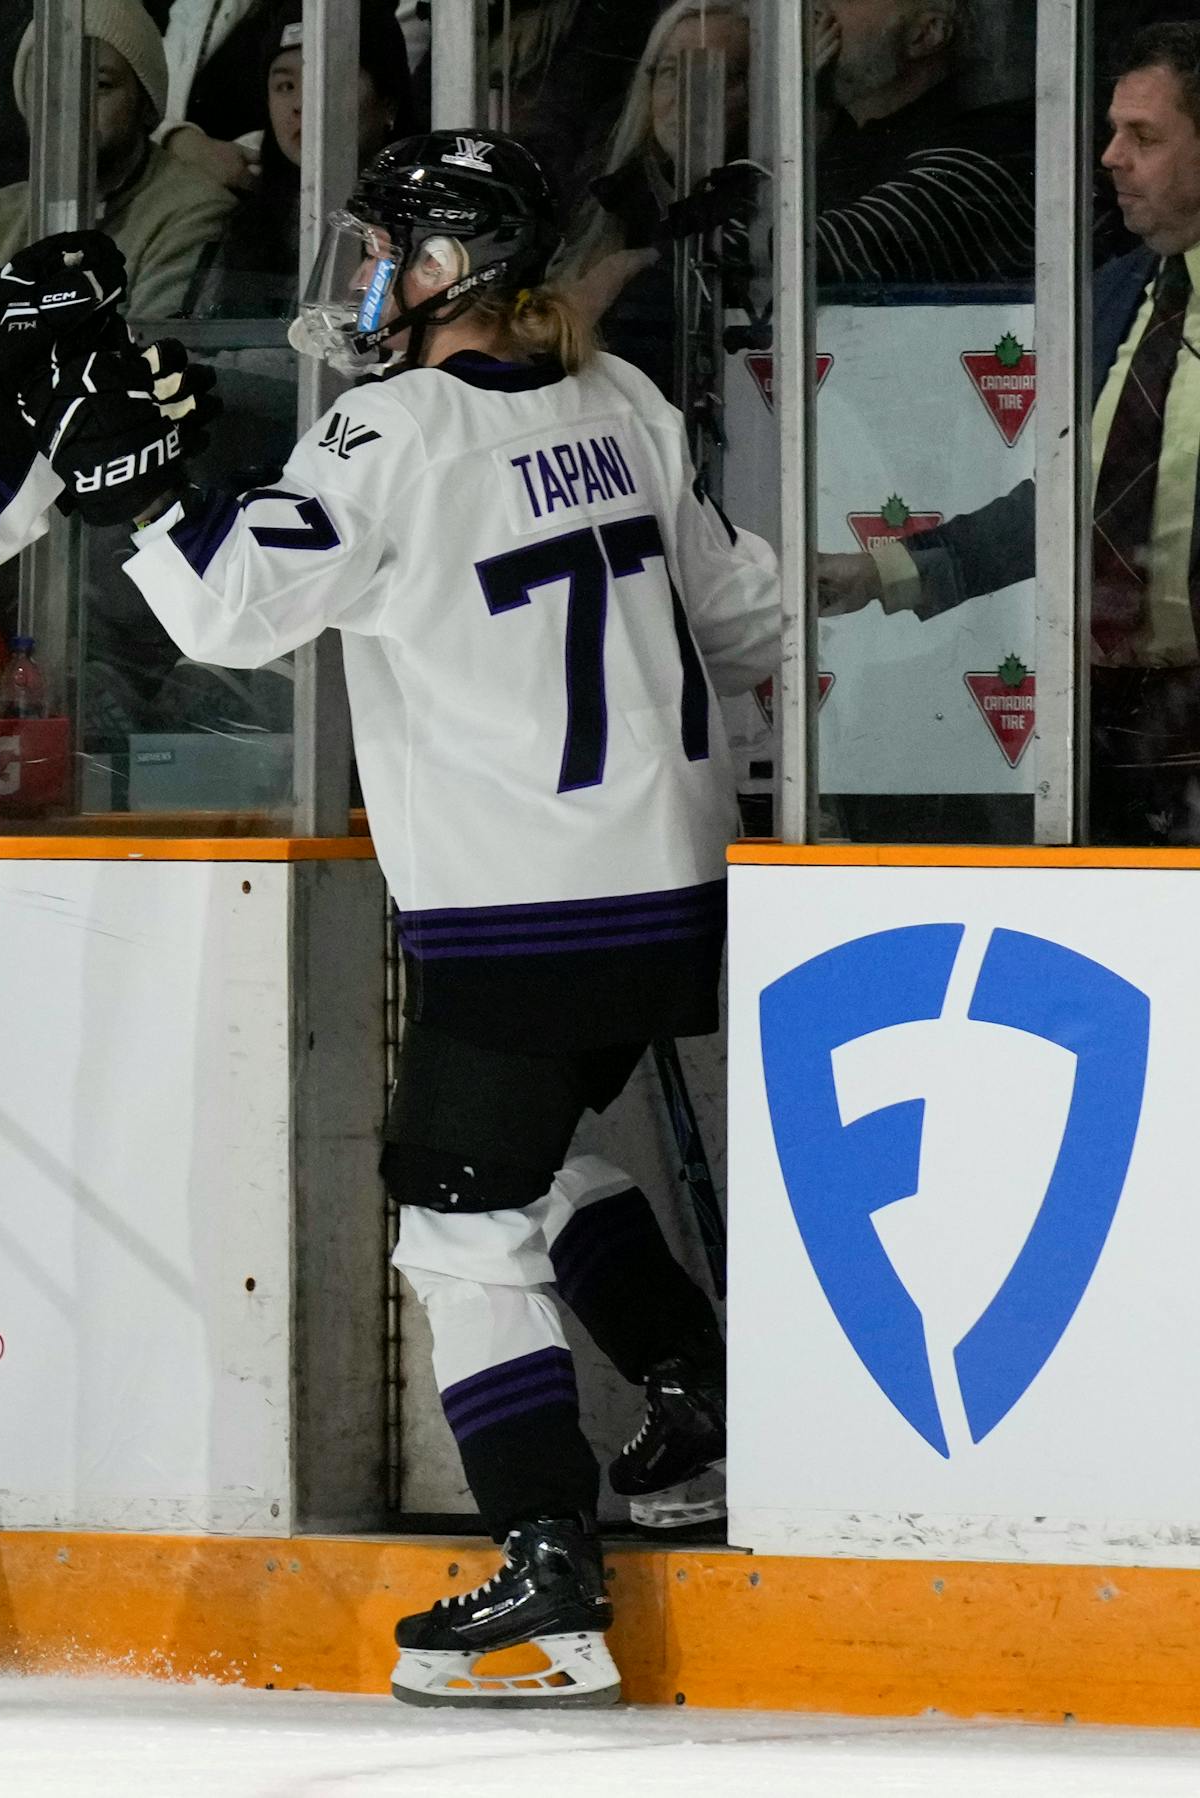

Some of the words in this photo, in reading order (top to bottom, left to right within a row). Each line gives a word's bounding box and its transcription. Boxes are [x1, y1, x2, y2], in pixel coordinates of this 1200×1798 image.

[41, 291, 78, 304] CCM
[7, 320, 37, 333] FTW
[997, 393, 1024, 411] TIRE
[510, 434, 638, 519] TAPANI
[473, 514, 710, 795] 77
[1000, 715, 1026, 730] TIRE
